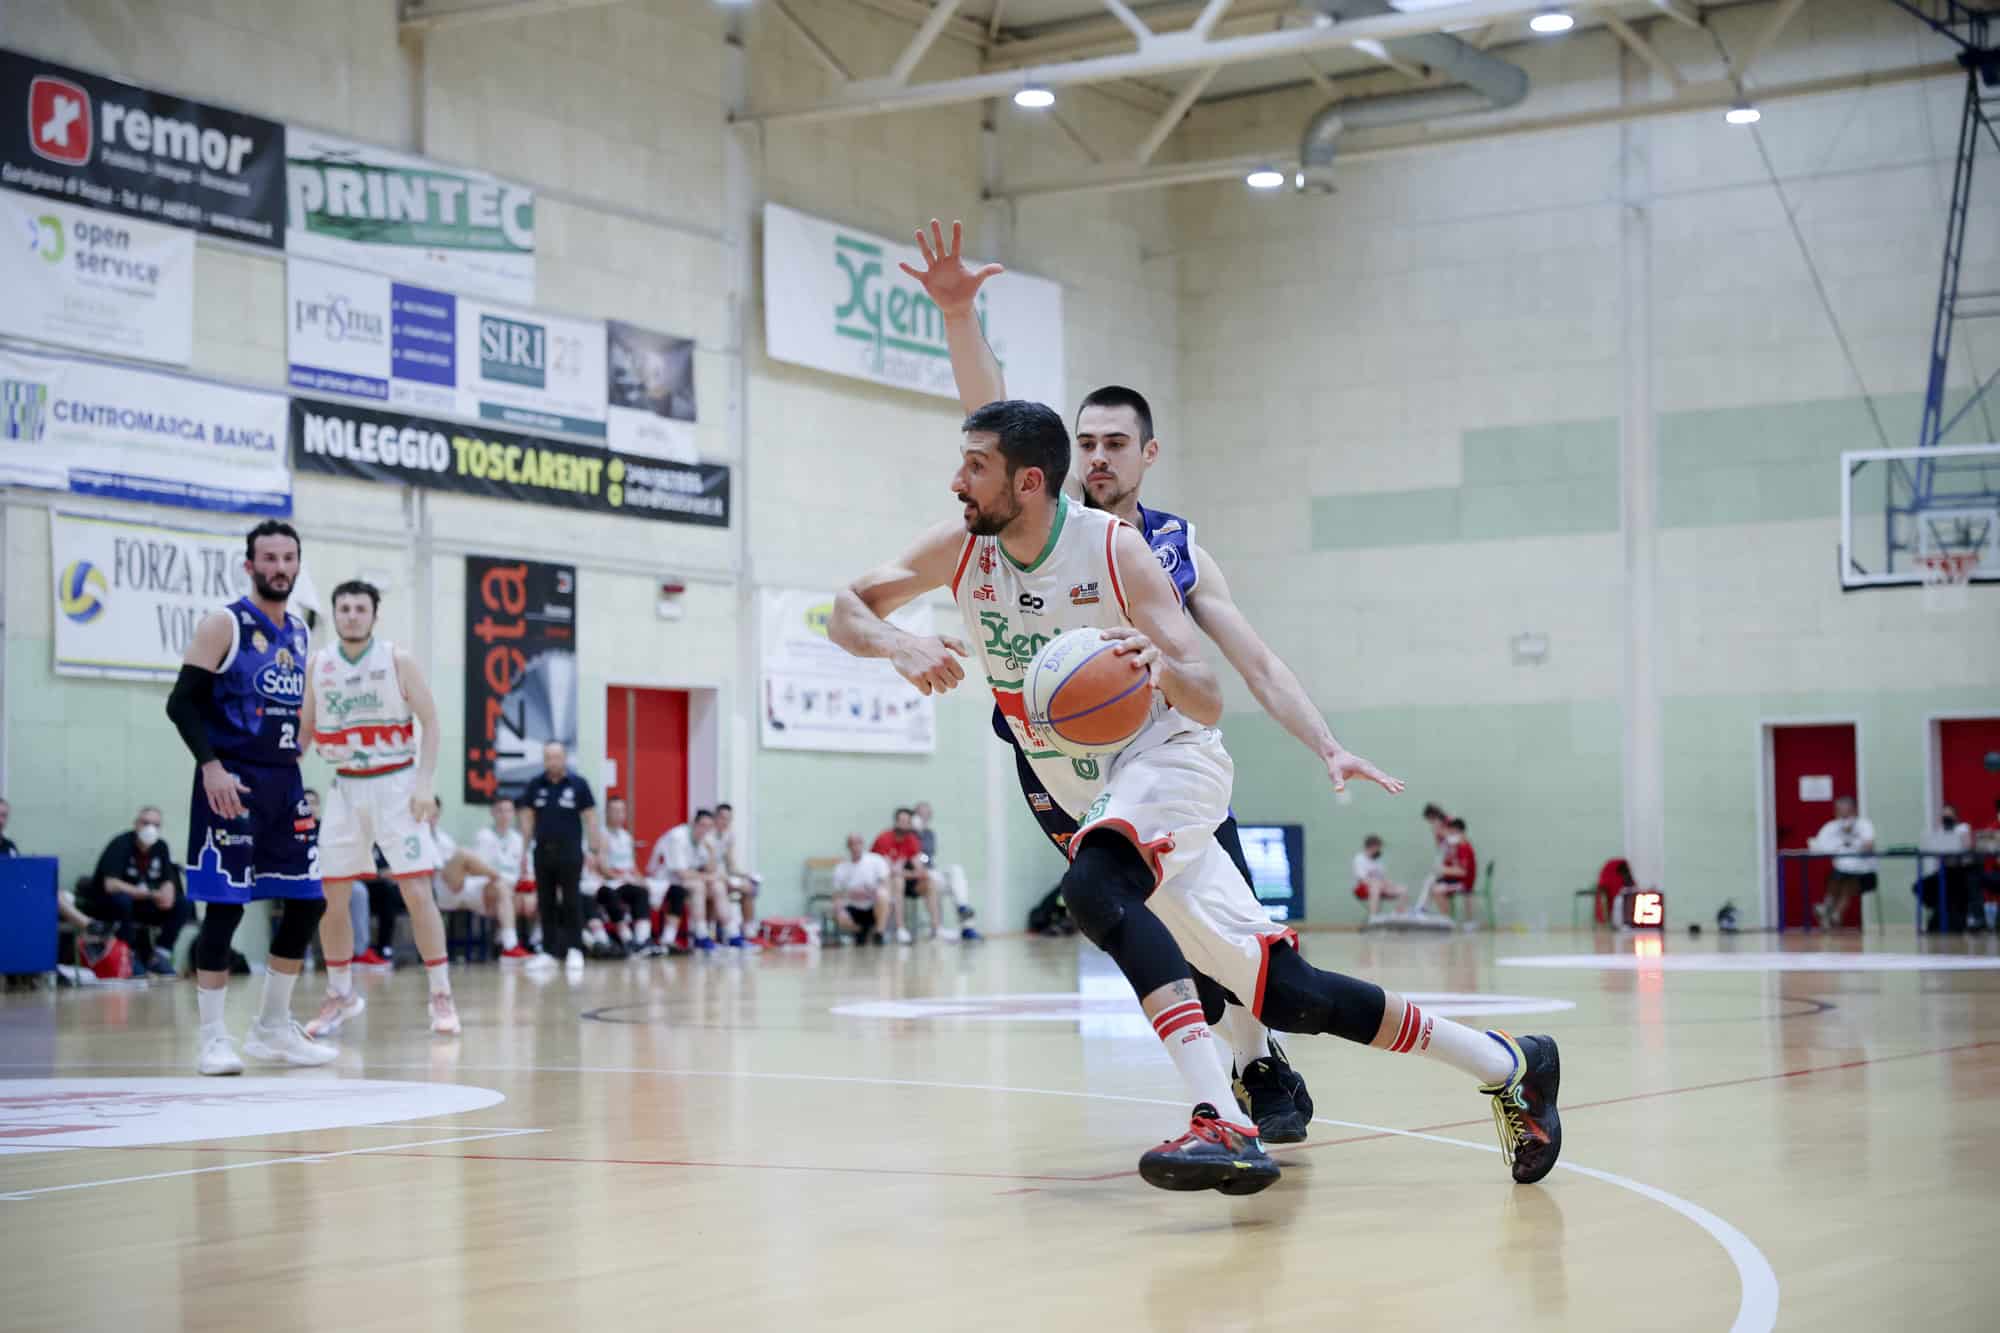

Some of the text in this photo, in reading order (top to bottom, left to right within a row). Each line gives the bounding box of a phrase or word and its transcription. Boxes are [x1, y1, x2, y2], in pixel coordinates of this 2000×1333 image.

[102, 101, 253, 174] remor
[287, 166, 536, 250] PRINTEC
[73, 219, 131, 250] open
[74, 250, 159, 284] service
[481, 321, 543, 369] SIRI
[53, 400, 206, 443] CENTROMARCA
[213, 423, 276, 452] BANCA
[303, 412, 449, 473] NOLEGGIO
[451, 434, 604, 495] TOSCARENT
[113, 536, 193, 597] FORZA
[404, 836, 421, 860] 3
[1634, 893, 1663, 925] 15
